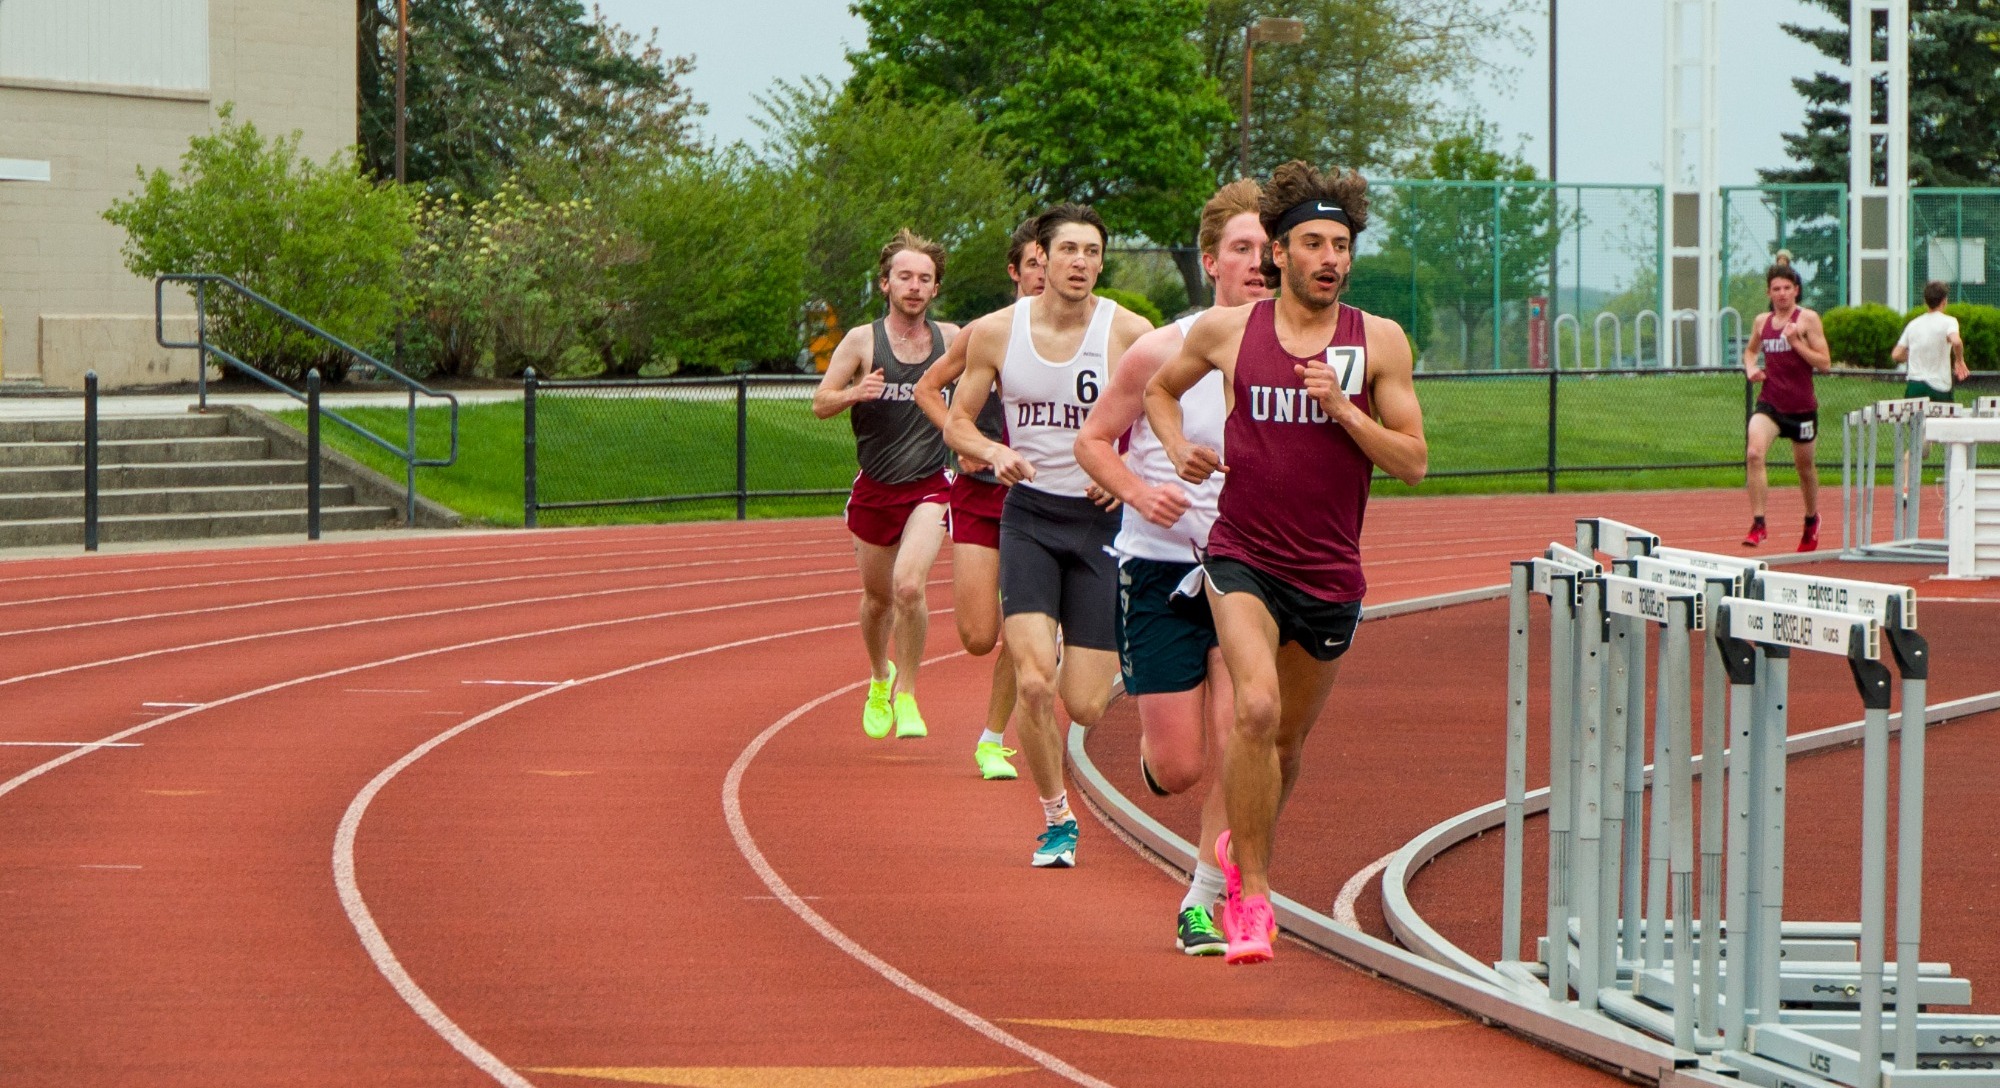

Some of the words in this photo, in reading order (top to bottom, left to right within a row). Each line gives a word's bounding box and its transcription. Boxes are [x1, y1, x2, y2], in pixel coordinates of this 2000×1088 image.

[1076, 369, 1099, 404] 6
[1334, 349, 1357, 391] 7
[1250, 385, 1338, 424] UNIO
[1772, 611, 1813, 646] RENSSELAER
[1809, 1052, 1831, 1074] UCS
